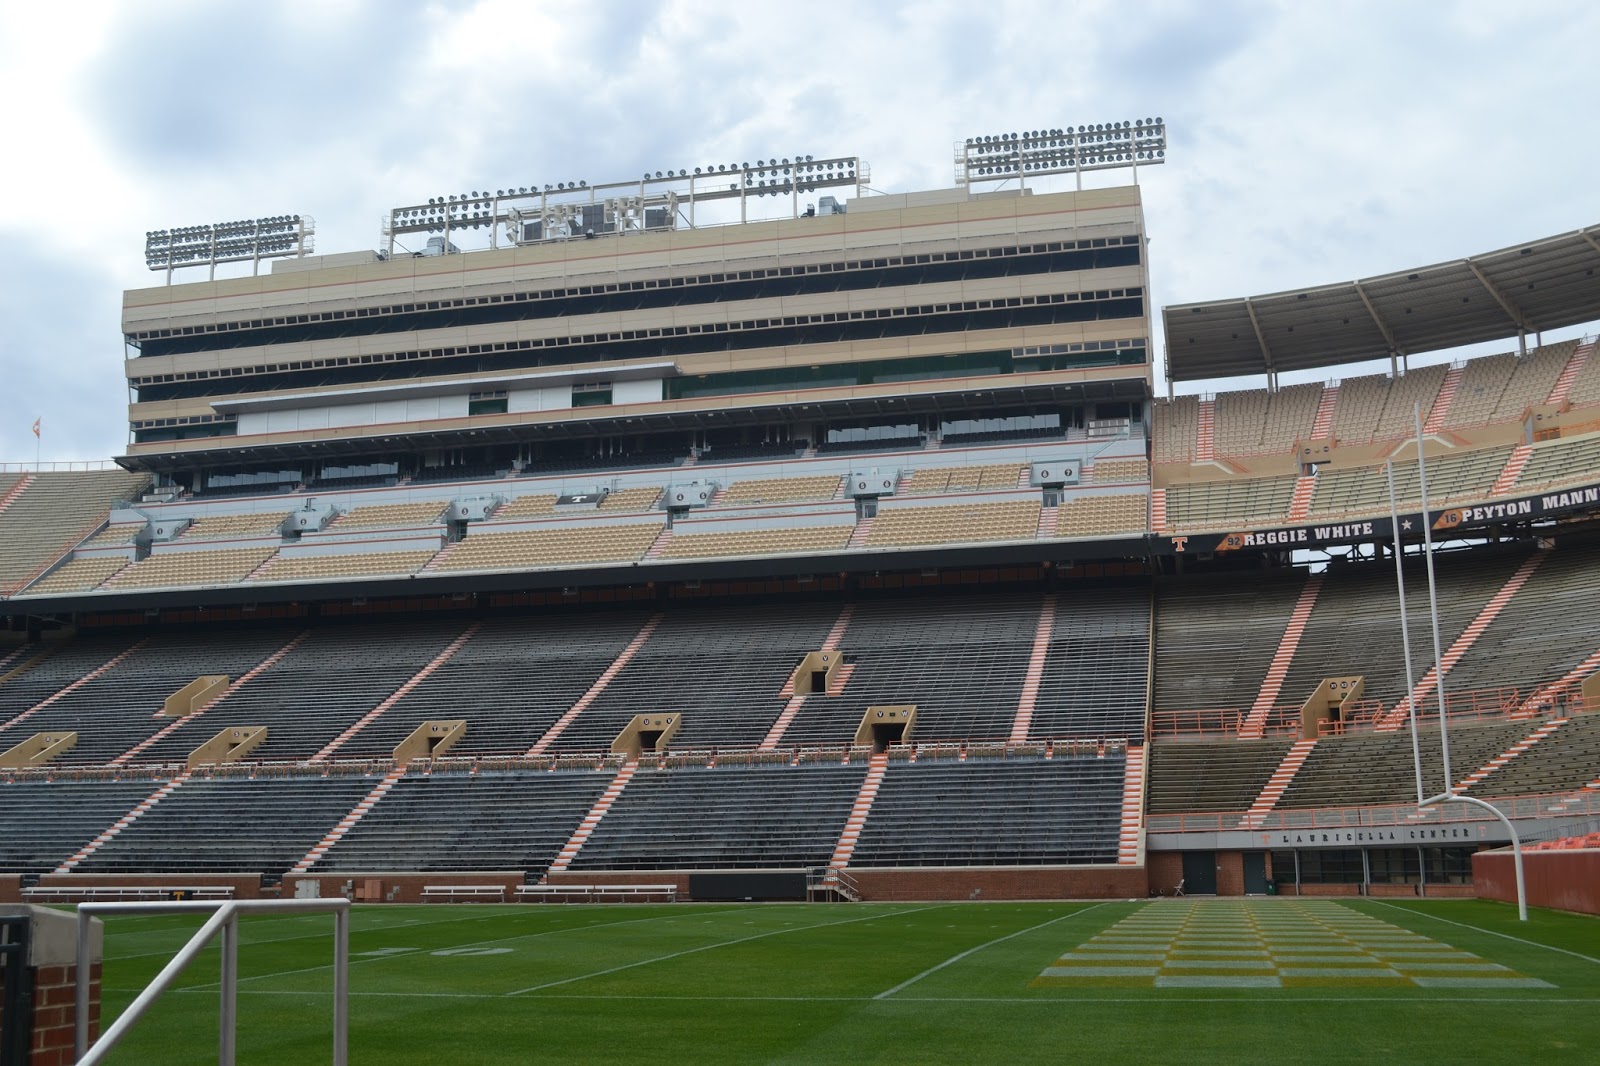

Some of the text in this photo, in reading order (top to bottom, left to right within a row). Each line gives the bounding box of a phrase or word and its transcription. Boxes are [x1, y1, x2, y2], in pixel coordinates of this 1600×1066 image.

[1445, 487, 1600, 524] 16 PEYTON MANN
[1228, 522, 1373, 546] 92 REGGIE WHITE
[1172, 537, 1188, 552] T
[1284, 832, 1394, 842] LAURICELLA
[1410, 829, 1468, 839] CENTER
